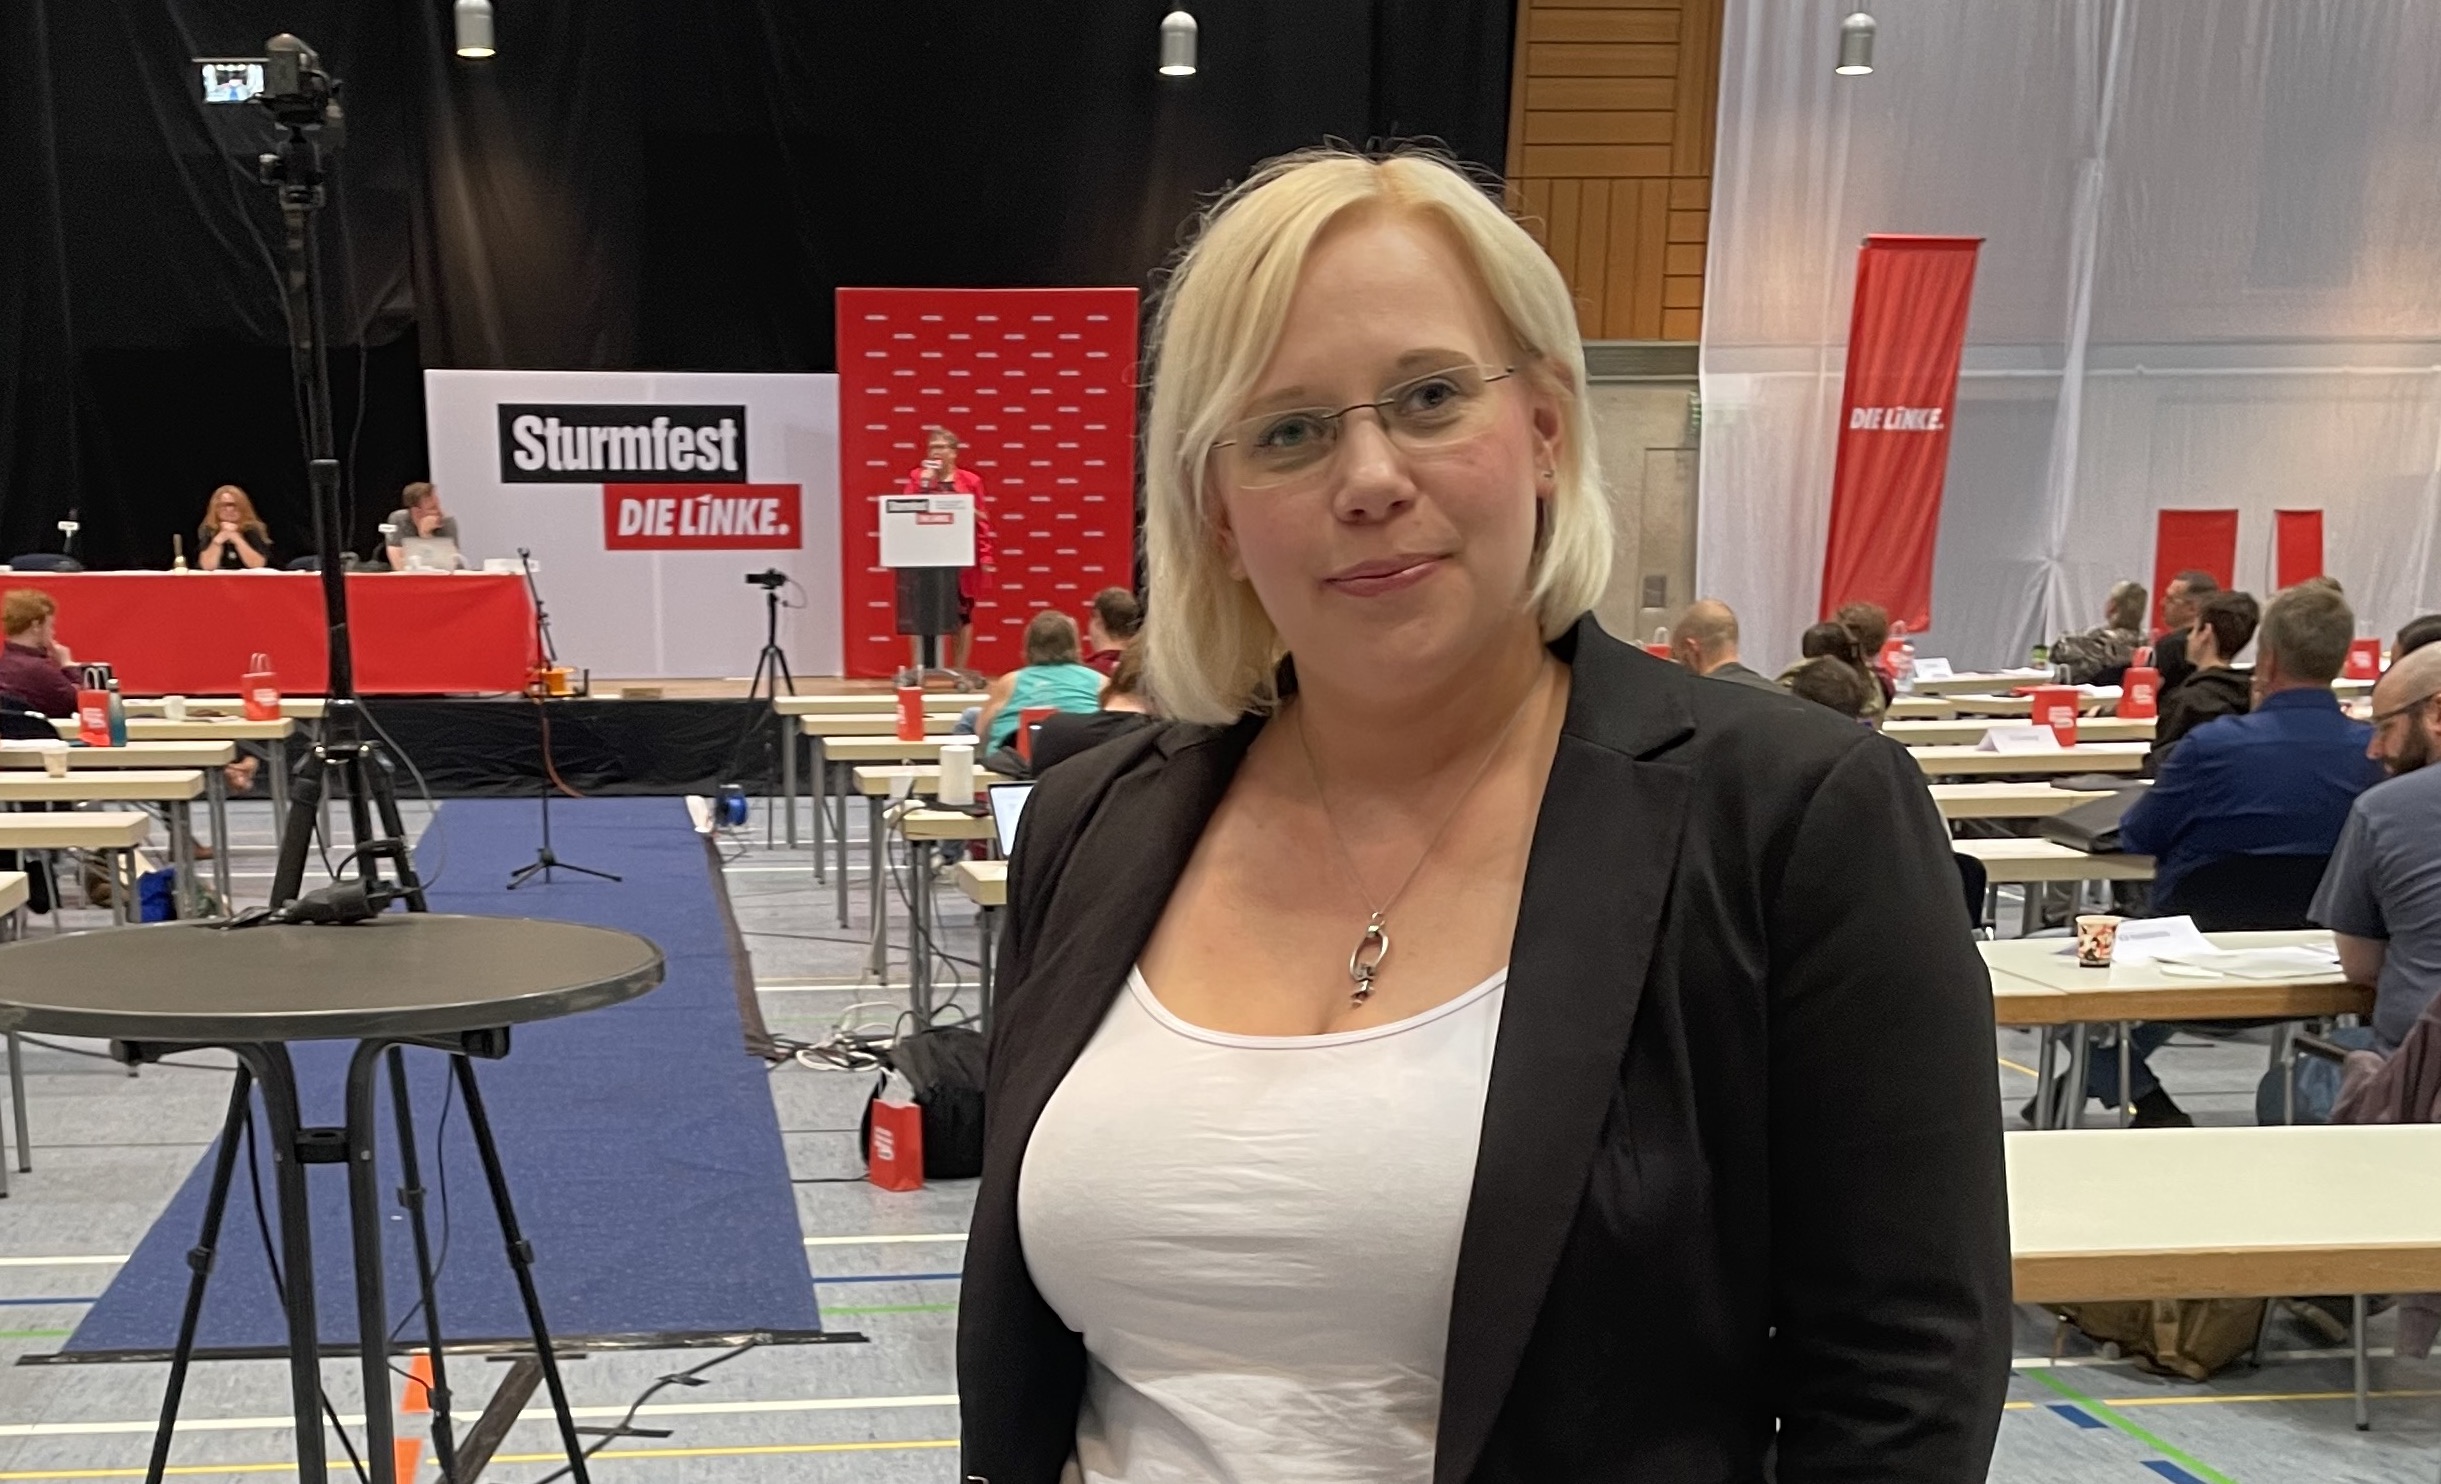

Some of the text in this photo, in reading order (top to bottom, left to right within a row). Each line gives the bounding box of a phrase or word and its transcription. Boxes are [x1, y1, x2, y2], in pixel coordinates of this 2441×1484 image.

[1850, 407, 1884, 430] DIE
[512, 414, 739, 472] Sturmfest
[617, 498, 676, 537] DIE
